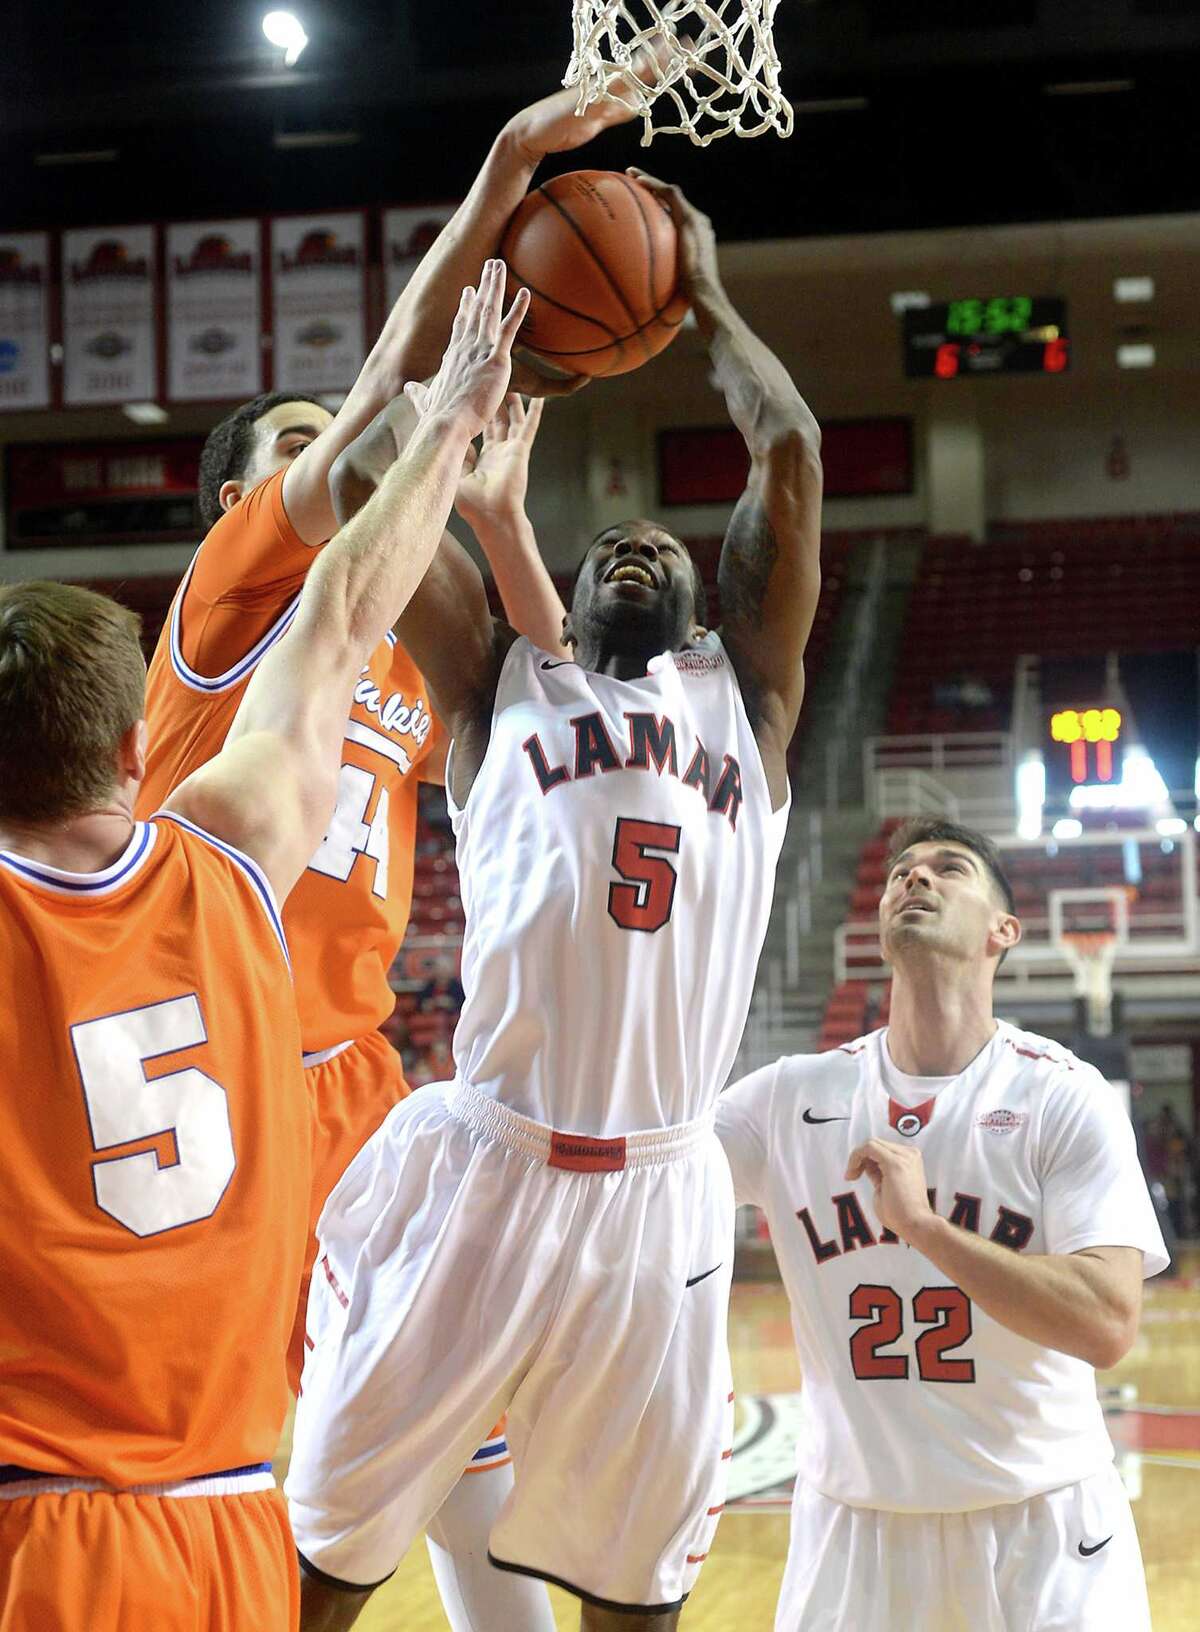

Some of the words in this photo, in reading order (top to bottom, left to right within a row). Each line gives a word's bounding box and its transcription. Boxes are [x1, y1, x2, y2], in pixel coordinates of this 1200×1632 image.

[522, 711, 743, 833] LAMAR
[607, 815, 682, 934] 5
[69, 992, 237, 1239] 5
[849, 1283, 976, 1384] 22
